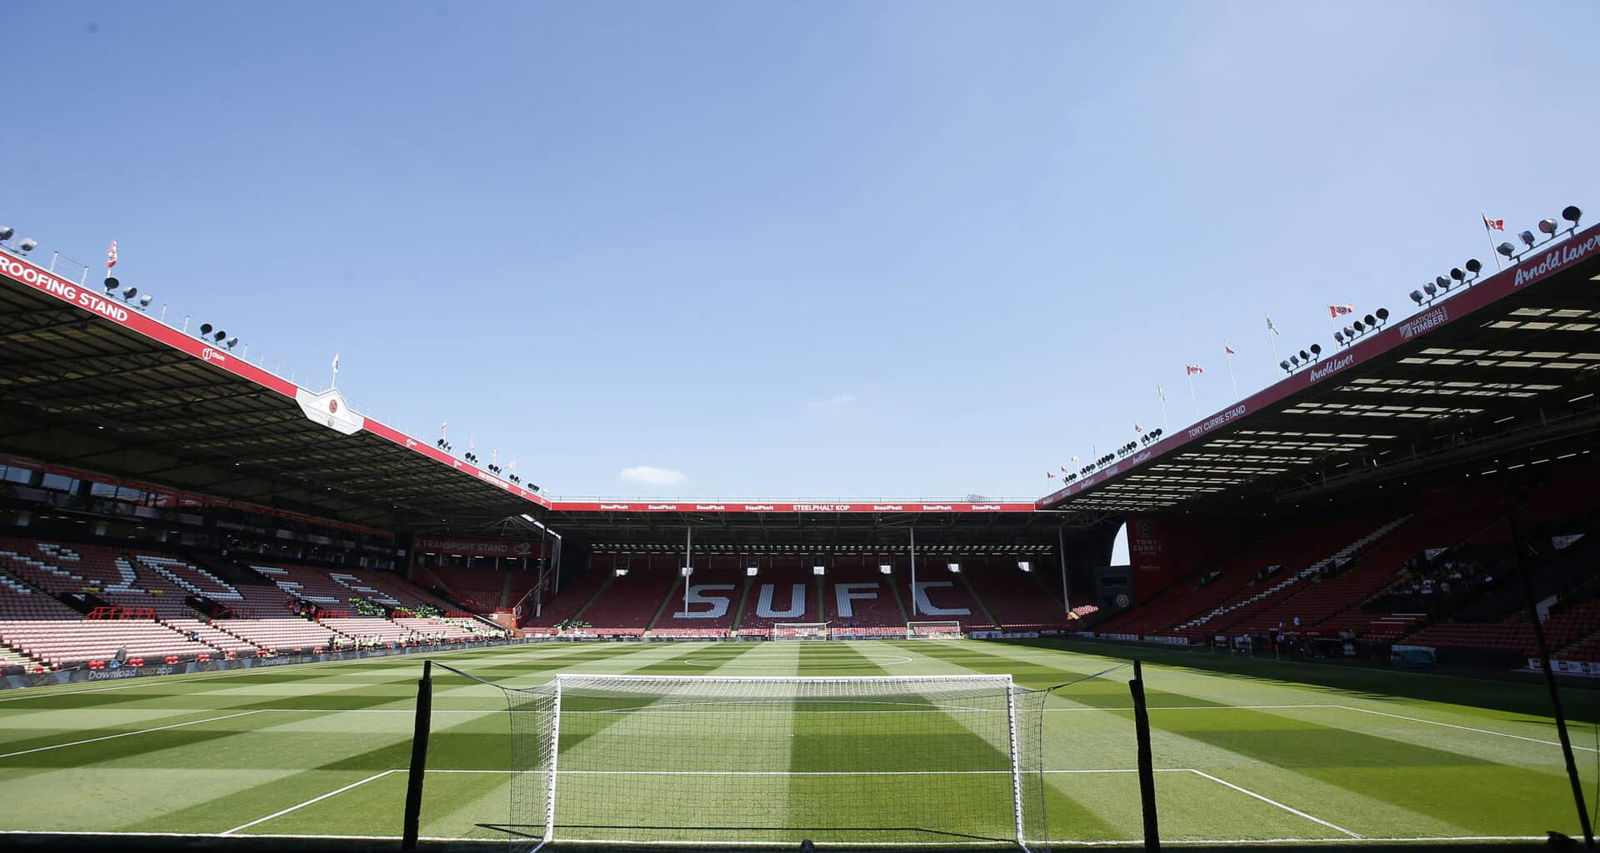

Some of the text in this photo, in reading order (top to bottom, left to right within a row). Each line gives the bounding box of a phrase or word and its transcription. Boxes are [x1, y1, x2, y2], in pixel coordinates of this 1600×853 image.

[1514, 234, 1600, 286] Arnold Laver
[0, 256, 128, 322] ROOFING STAND
[1410, 308, 1443, 326] NATIONAL
[1411, 315, 1445, 335] TIMBER
[1310, 354, 1354, 382] Arnold Laver
[1188, 405, 1246, 438] TONY CURRIE STAND
[422, 540, 474, 552] TRANSPORT
[478, 543, 508, 553] STAND
[88, 667, 137, 681] Download
[156, 667, 173, 676] app
